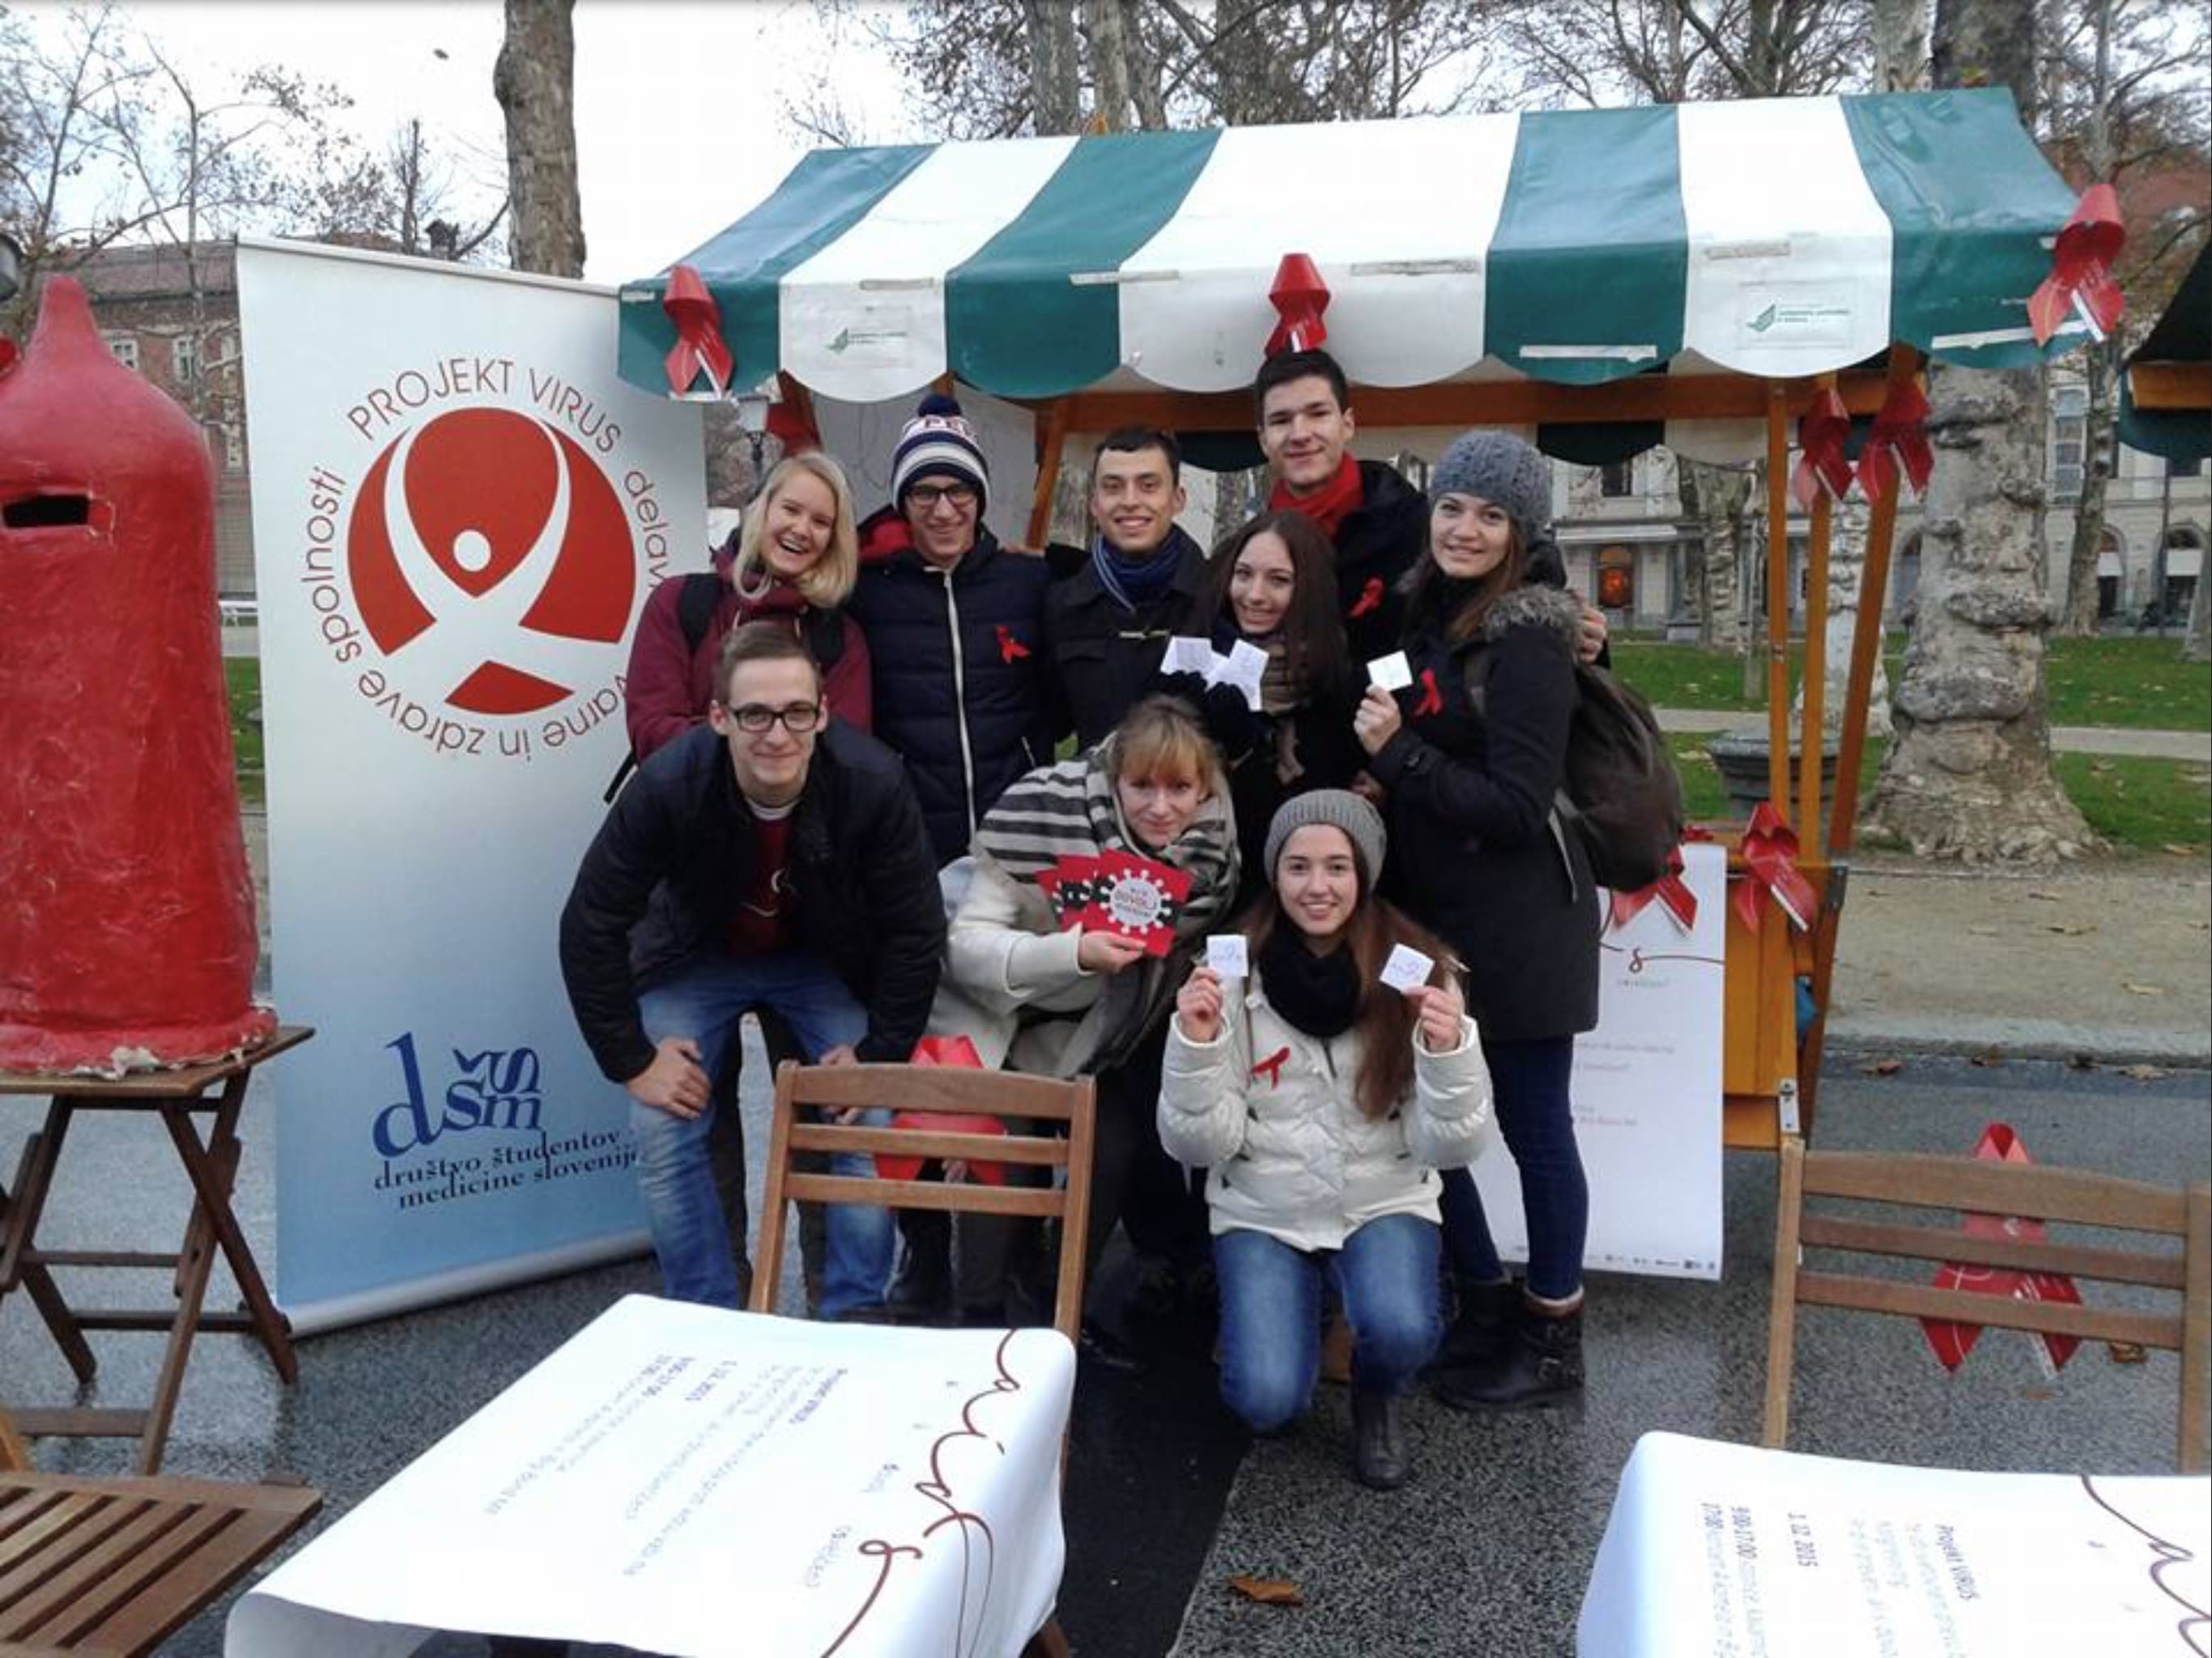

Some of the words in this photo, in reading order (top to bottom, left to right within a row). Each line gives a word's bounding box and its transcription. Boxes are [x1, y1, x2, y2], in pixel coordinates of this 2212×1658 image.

[347, 358, 514, 441] PROJEKT
[530, 368, 622, 453] VIRUS
[302, 466, 364, 663] spolnosti
[624, 471, 669, 589] delav
[359, 670, 487, 754] zdrave
[500, 730, 531, 761] in
[374, 1160, 483, 1190] društvo
[491, 1130, 621, 1167] študentov
[398, 1171, 525, 1209] medicine
